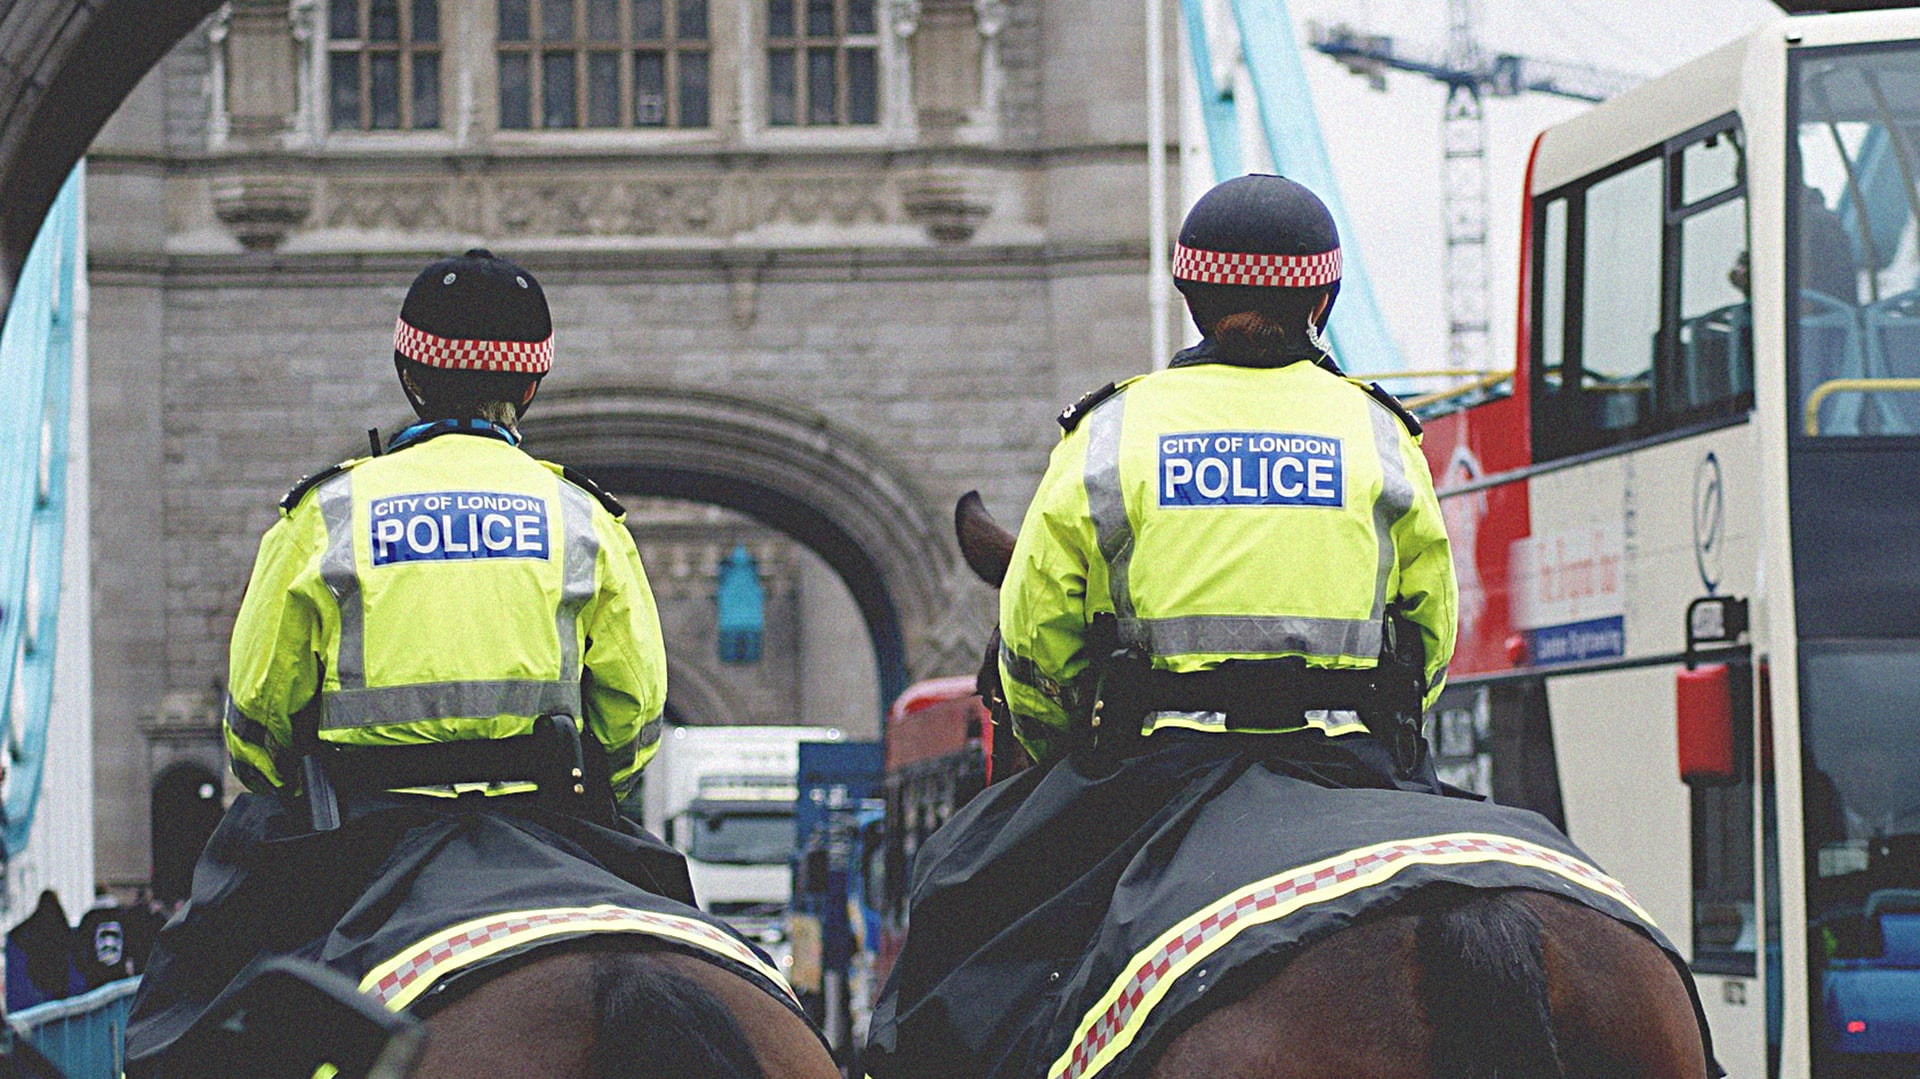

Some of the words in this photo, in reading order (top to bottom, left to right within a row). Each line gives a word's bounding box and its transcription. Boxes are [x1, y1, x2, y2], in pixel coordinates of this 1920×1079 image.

[1163, 439, 1210, 454] CITY
[1215, 438, 1243, 453] OF
[1249, 438, 1336, 456] LONDON
[1165, 457, 1335, 498] POLICE
[374, 499, 418, 516] CITY
[424, 496, 451, 511] OF
[457, 496, 541, 513] LONDON
[377, 514, 543, 557] POLICE
